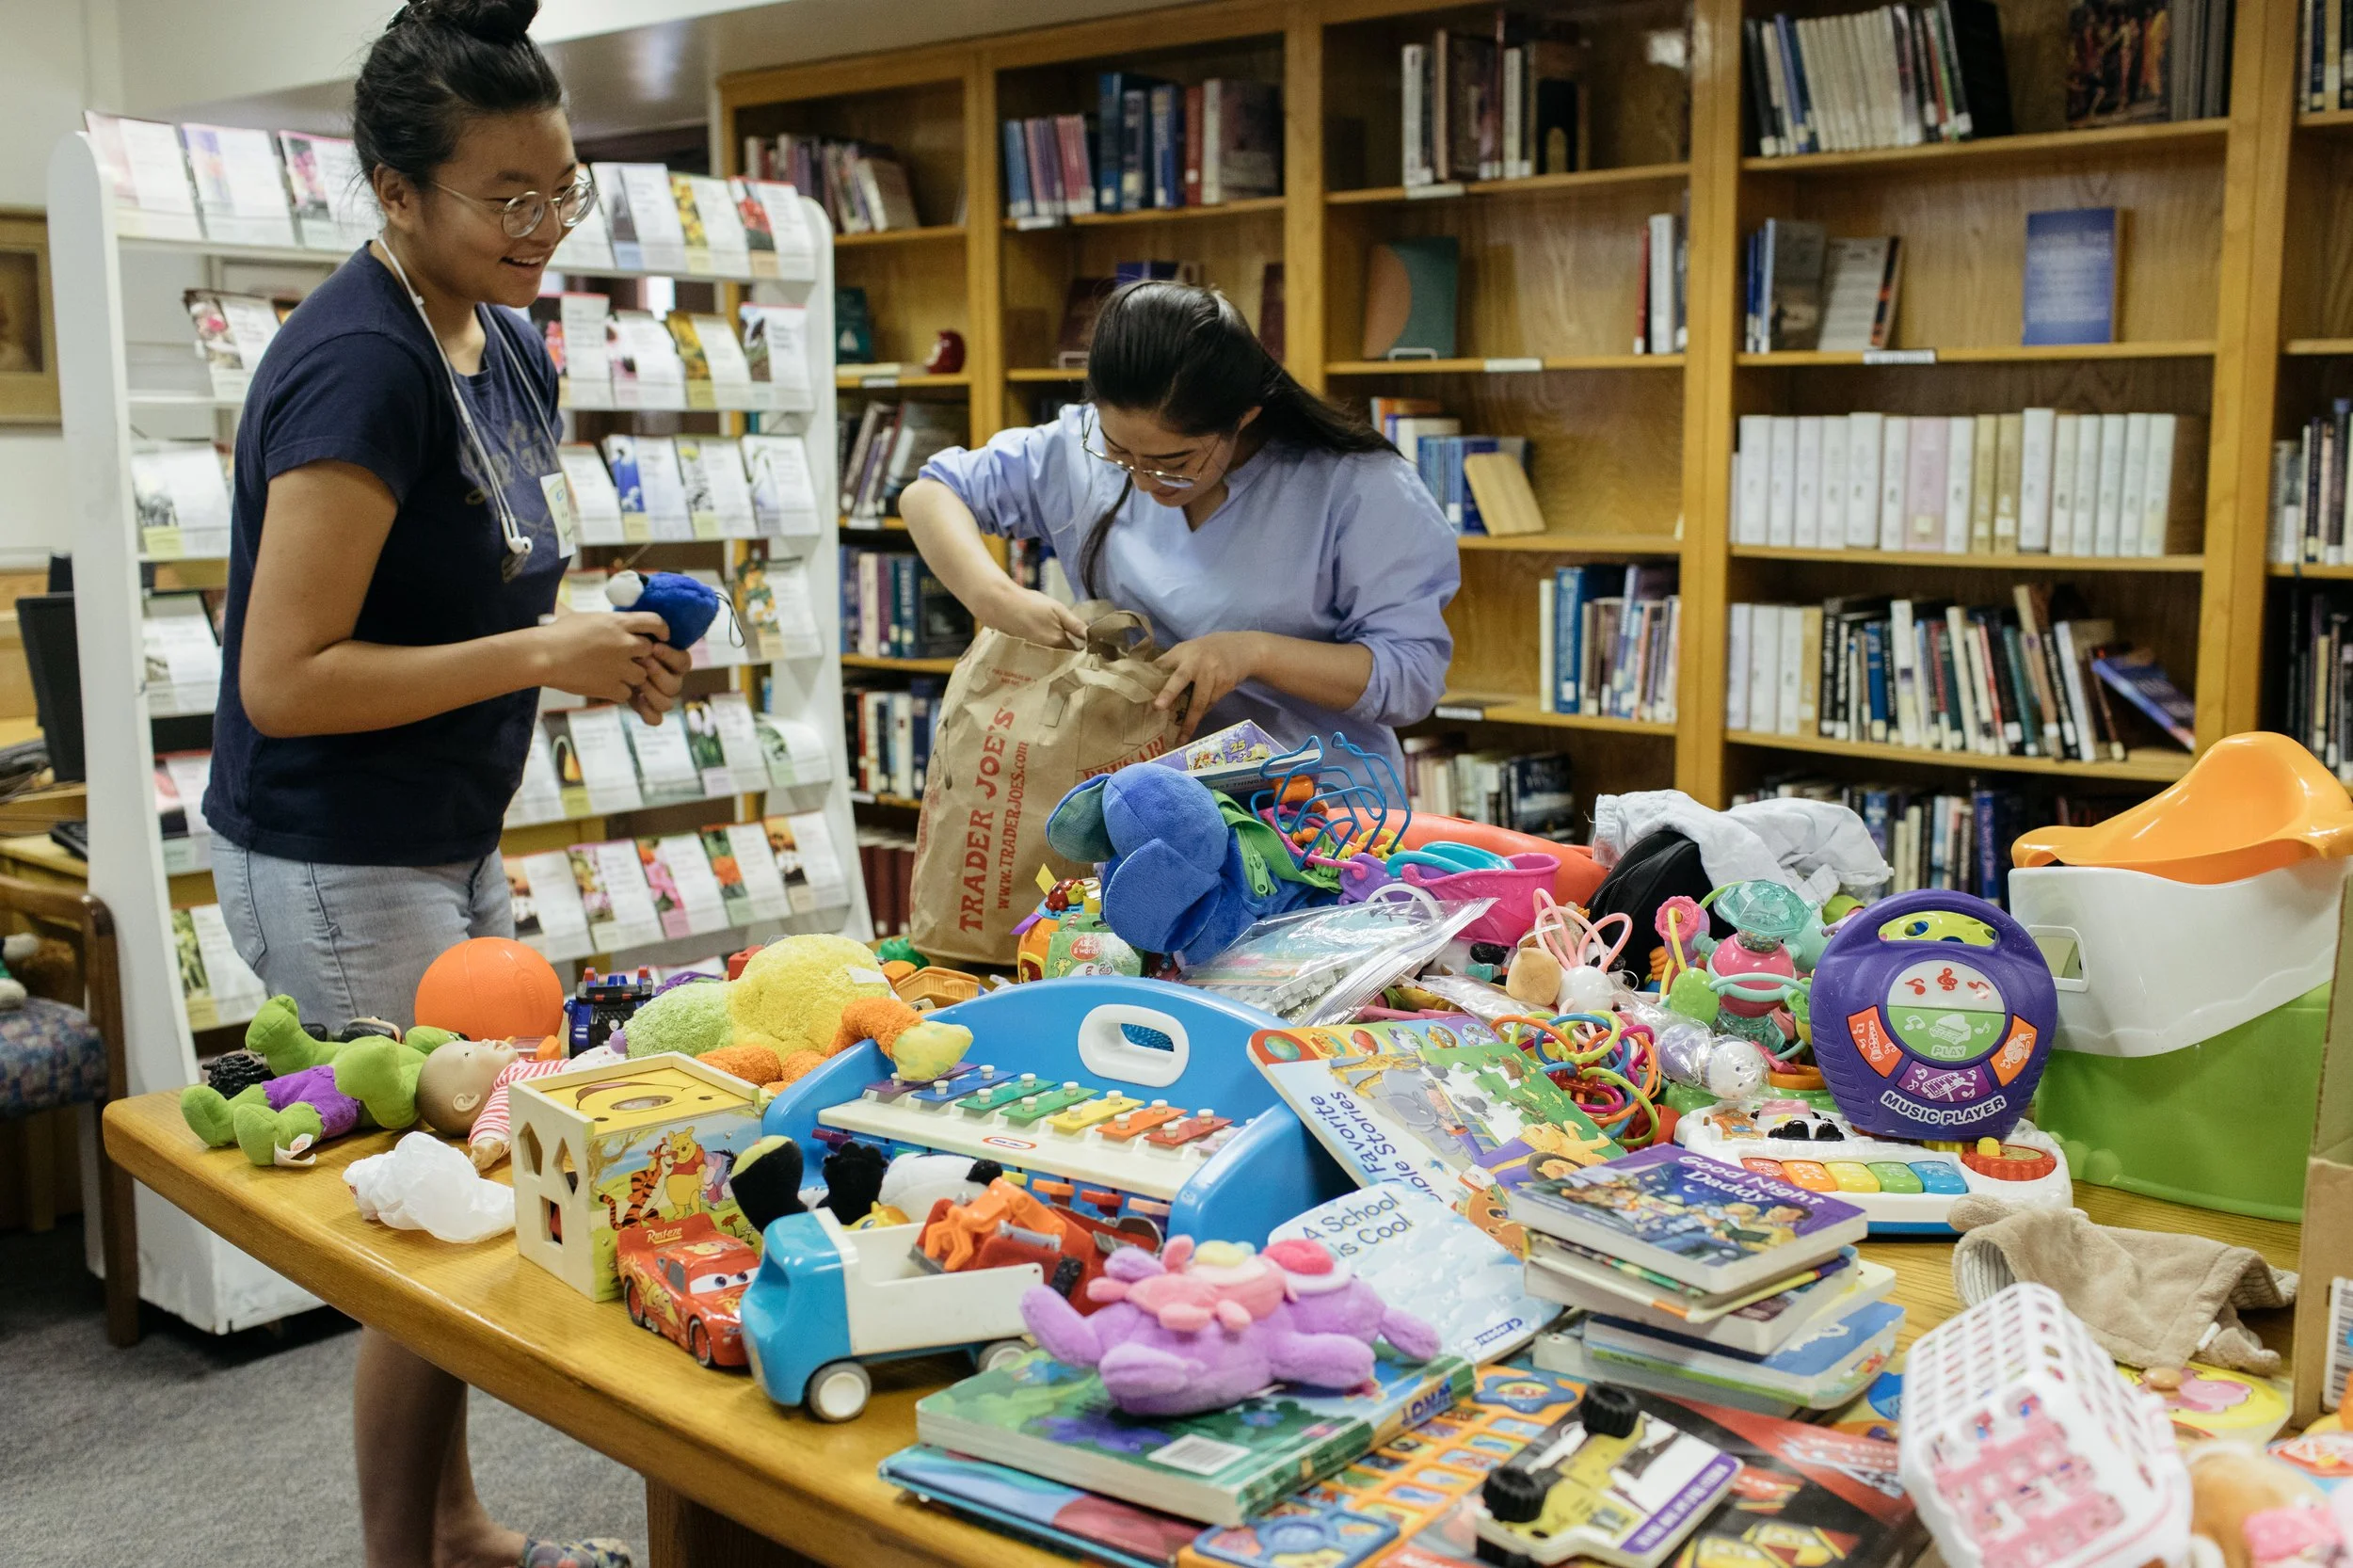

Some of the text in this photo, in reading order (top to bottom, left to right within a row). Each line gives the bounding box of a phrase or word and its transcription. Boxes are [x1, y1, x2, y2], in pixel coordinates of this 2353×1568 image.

[975, 707, 1016, 801] JOE'S
[1230, 740, 1246, 753] 25
[958, 808, 995, 934] TRADER
[1932, 1046, 1965, 1056] PLAY
[1330, 1091, 1397, 1156] Stories
[1882, 1092, 2006, 1124] MUSIC PLAYER
[1310, 1095, 1386, 1175] Favorite
[1678, 1156, 1825, 1206] Good Night
[1682, 1171, 1774, 1202] Daddy
[1303, 1191, 1401, 1240] A School
[1356, 1212, 1414, 1245] Cool
